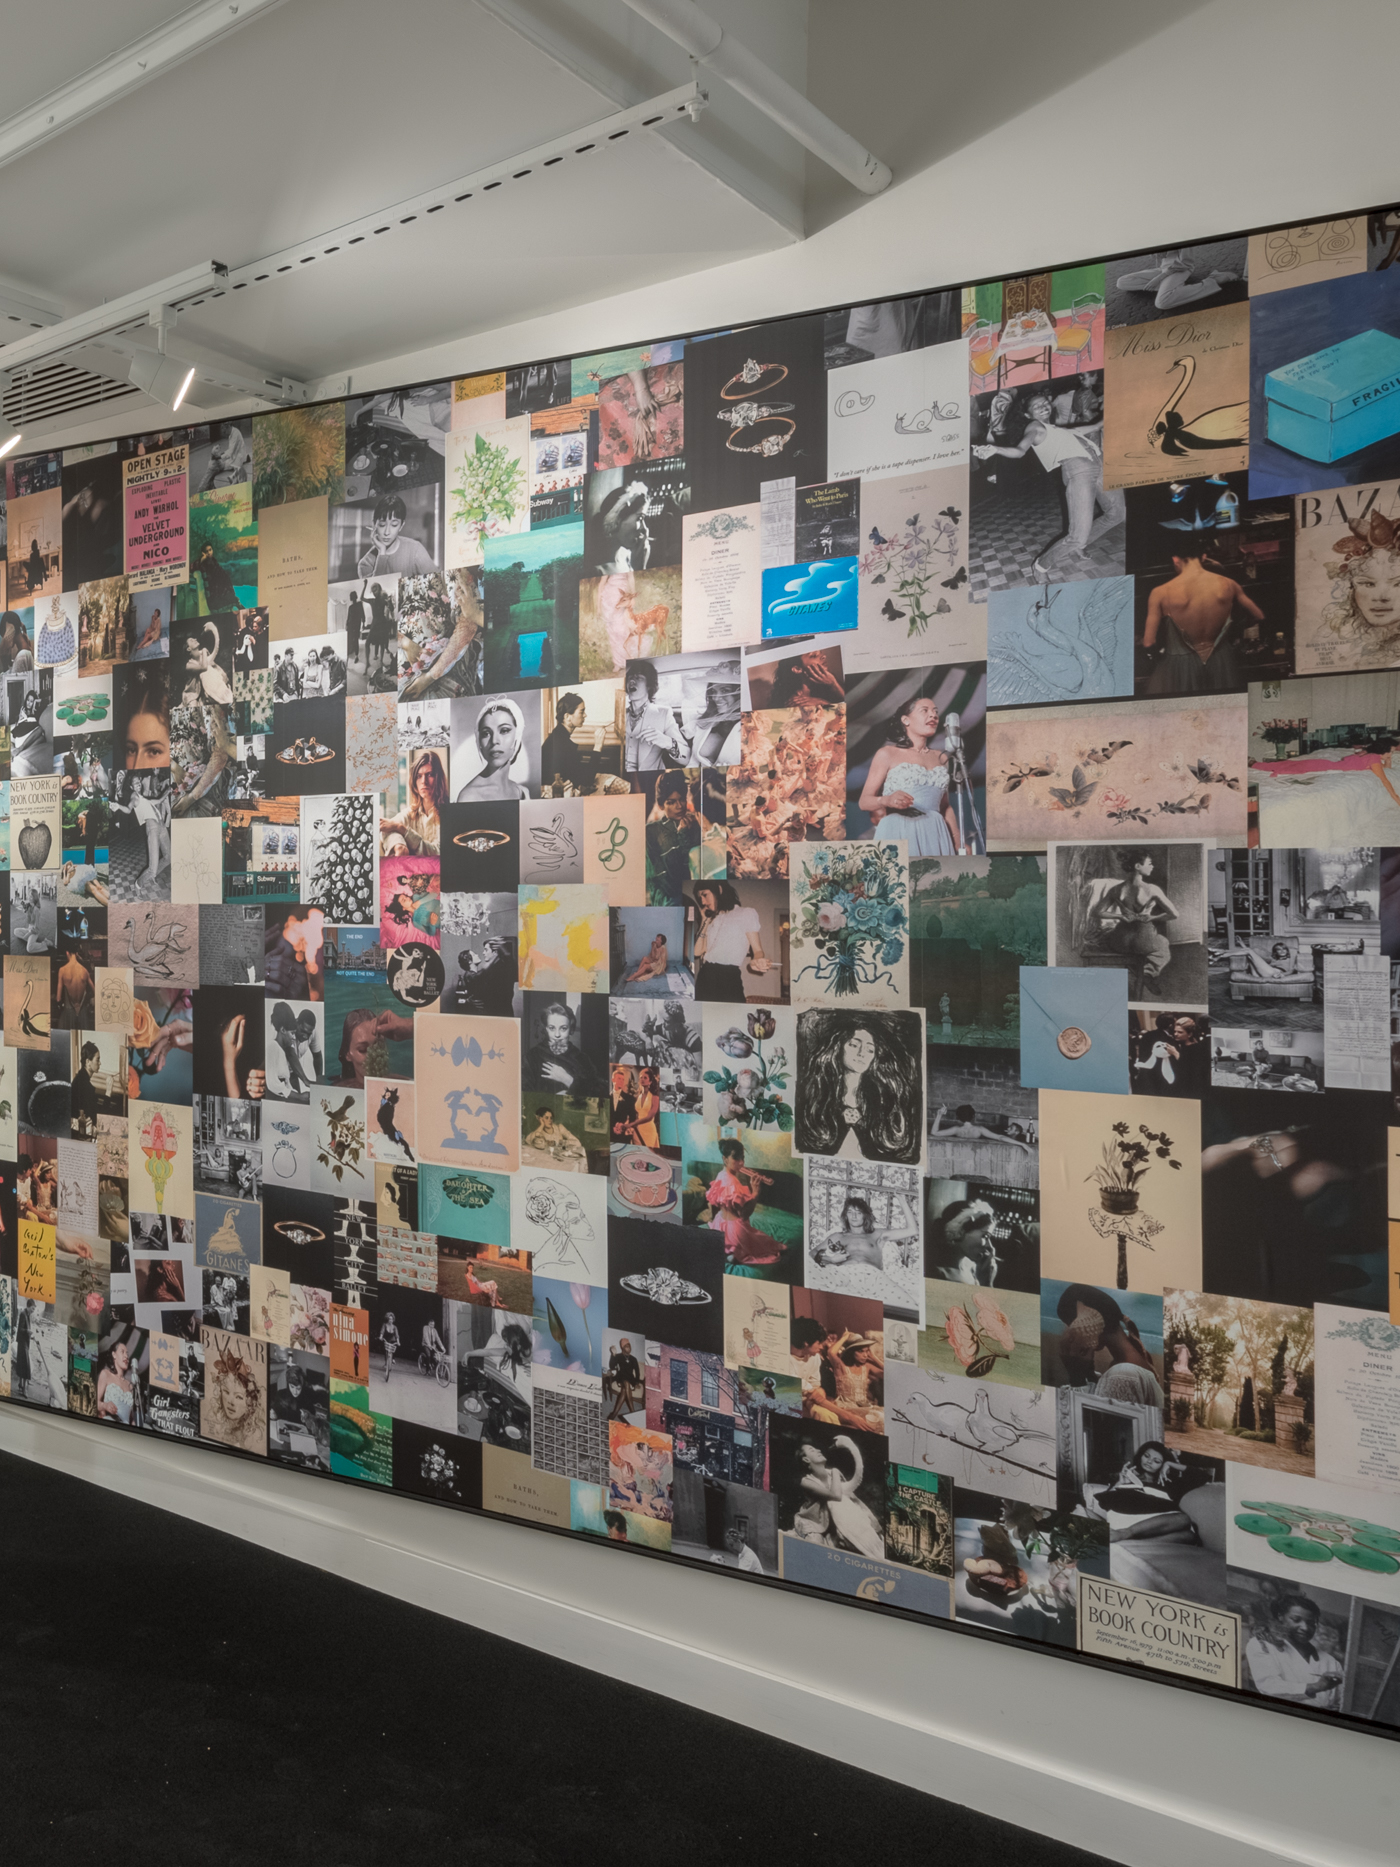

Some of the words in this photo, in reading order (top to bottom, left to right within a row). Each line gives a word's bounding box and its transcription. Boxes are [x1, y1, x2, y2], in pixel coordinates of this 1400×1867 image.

[1108, 330, 1161, 360] Miss
[1165, 323, 1212, 349] Dior
[128, 456, 151, 473] OPEN
[156, 448, 185, 464] STAGE
[892, 461, 904, 469] tape
[905, 456, 931, 466] dispenser.
[937, 452, 949, 460] love
[127, 471, 160, 485] NIGHTLY
[164, 477, 181, 487] PLASTIC
[134, 507, 149, 519] ANDY
[153, 501, 179, 515] WARHOL
[530, 498, 554, 508] Subway
[142, 519, 170, 534] VELVET
[129, 527, 184, 547] UNDERGROUND
[143, 546, 169, 560] NICO
[282, 555, 303, 564] BATHS,
[788, 601, 833, 617] GITANES
[10, 782, 27, 792] NEW
[30, 780, 51, 790] YORK
[10, 794, 28, 805] BOOK
[28, 792, 58, 804] COUNTRY
[446, 1179, 491, 1192] DAUGHTER
[449, 1193, 466, 1202] THE
[469, 1197, 484, 1205] SEA
[345, 1214, 363, 1223] NEW
[344, 1237, 365, 1247] YORK
[206, 1251, 250, 1273] GITANES
[345, 1261, 363, 1269] CITY
[25, 1263, 44, 1277] New
[341, 1282, 368, 1293] BALLET
[332, 1311, 355, 1330] nina
[333, 1326, 369, 1346] simone
[201, 1329, 265, 1364] BAZAAR
[1367, 1352, 1393, 1360] MENU
[1363, 1362, 1393, 1371] DINER
[153, 1395, 170, 1407] Girl
[150, 1407, 190, 1421] Gangsters
[157, 1419, 174, 1431] THAT
[175, 1424, 195, 1437] FLOUT
[513, 1484, 539, 1497] BATHS,
[903, 1487, 936, 1500] CAPTURE
[898, 1491, 912, 1500] THE
[913, 1494, 942, 1507] CASTLE
[827, 1552, 841, 1562] 20
[844, 1557, 901, 1579] CIGARETTES
[1088, 1584, 1137, 1610] NEW
[1145, 1599, 1207, 1631] YORK
[1214, 1622, 1229, 1637] is
[1088, 1606, 1137, 1634] BOOK
[1141, 1620, 1230, 1659] COUNTRY
[1095, 1629, 1128, 1643] September
[1095, 1636, 1113, 1645] Fifth
[1114, 1641, 1140, 1652] Avenue
[1145, 1651, 1163, 1661] 47th
[1173, 1657, 1191, 1668] 57th
[1191, 1663, 1218, 1675] Streets
